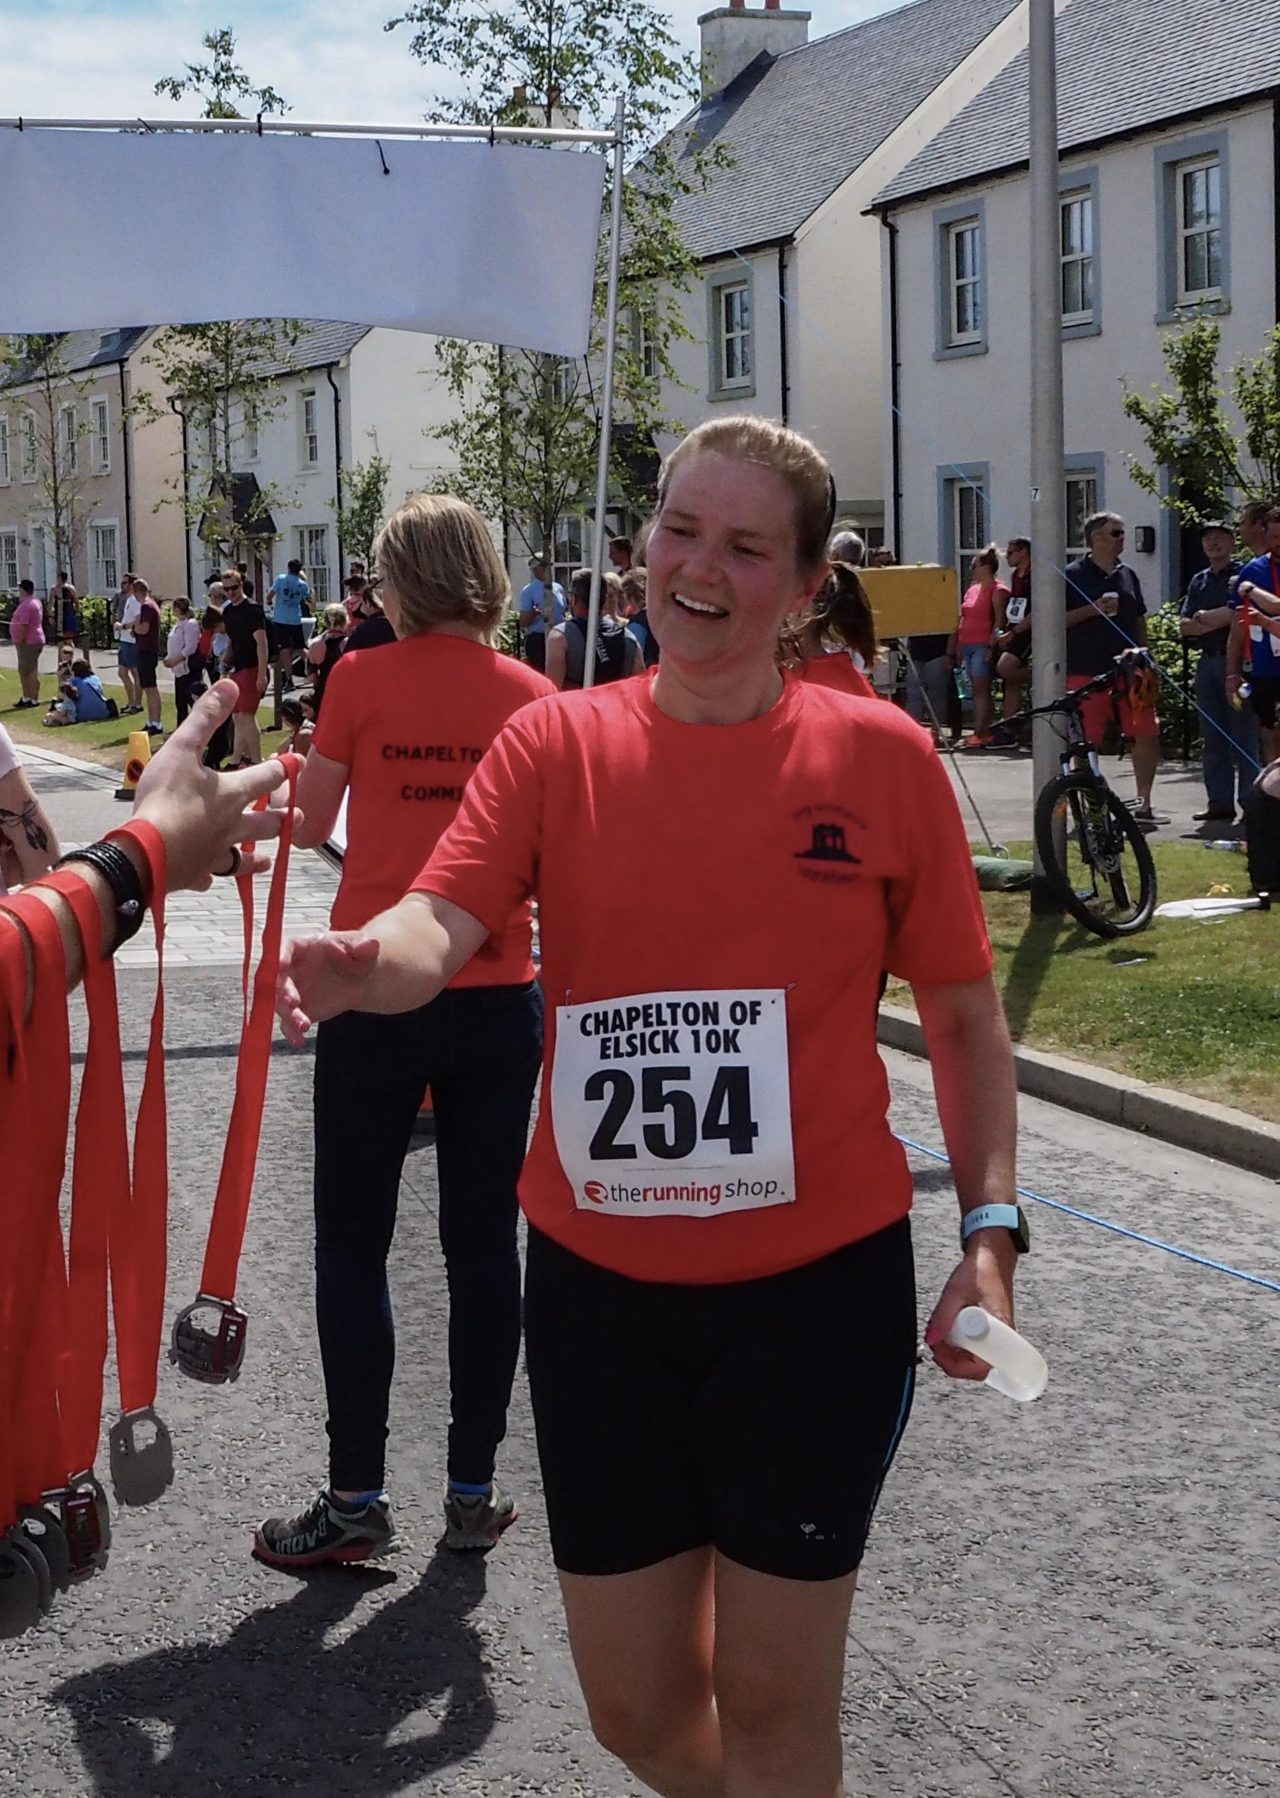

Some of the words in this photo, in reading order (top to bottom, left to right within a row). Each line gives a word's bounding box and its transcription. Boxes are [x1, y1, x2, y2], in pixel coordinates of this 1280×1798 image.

[580, 1001, 719, 1037] CHAPELTON
[729, 1000, 762, 1025] OF
[599, 1029, 680, 1060] ELSICK
[692, 1029, 741, 1053] 10K
[584, 1065, 759, 1160] 254
